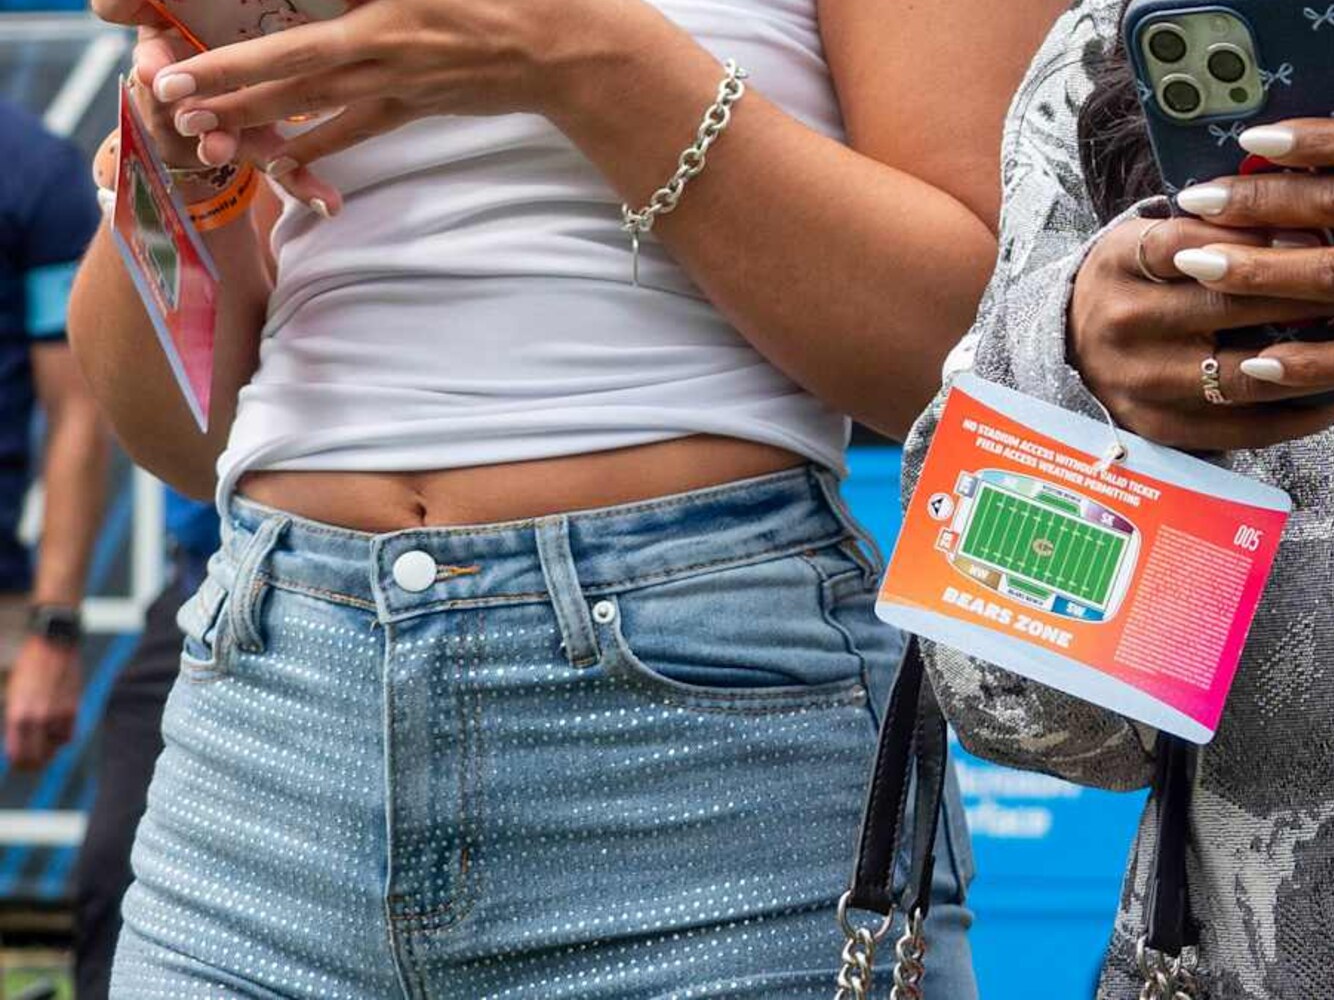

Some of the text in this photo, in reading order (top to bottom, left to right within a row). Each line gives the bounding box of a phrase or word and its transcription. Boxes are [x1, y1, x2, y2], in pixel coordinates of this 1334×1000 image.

[962, 418, 978, 434] NO
[977, 422, 1021, 448] STADIUM
[1019, 439, 1055, 460] ACCESS
[1055, 451, 1100, 479] WITHOUT
[1127, 477, 1162, 501] TICKET
[975, 436, 1004, 457] FIELD
[1002, 447, 1038, 469] ACCESS
[1037, 456, 1084, 486] WEATHER
[1083, 473, 1142, 508] PERMITTING
[1233, 524, 1264, 552] 005
[943, 586, 1013, 624] BEARS
[1014, 614, 1073, 647] ZONE
